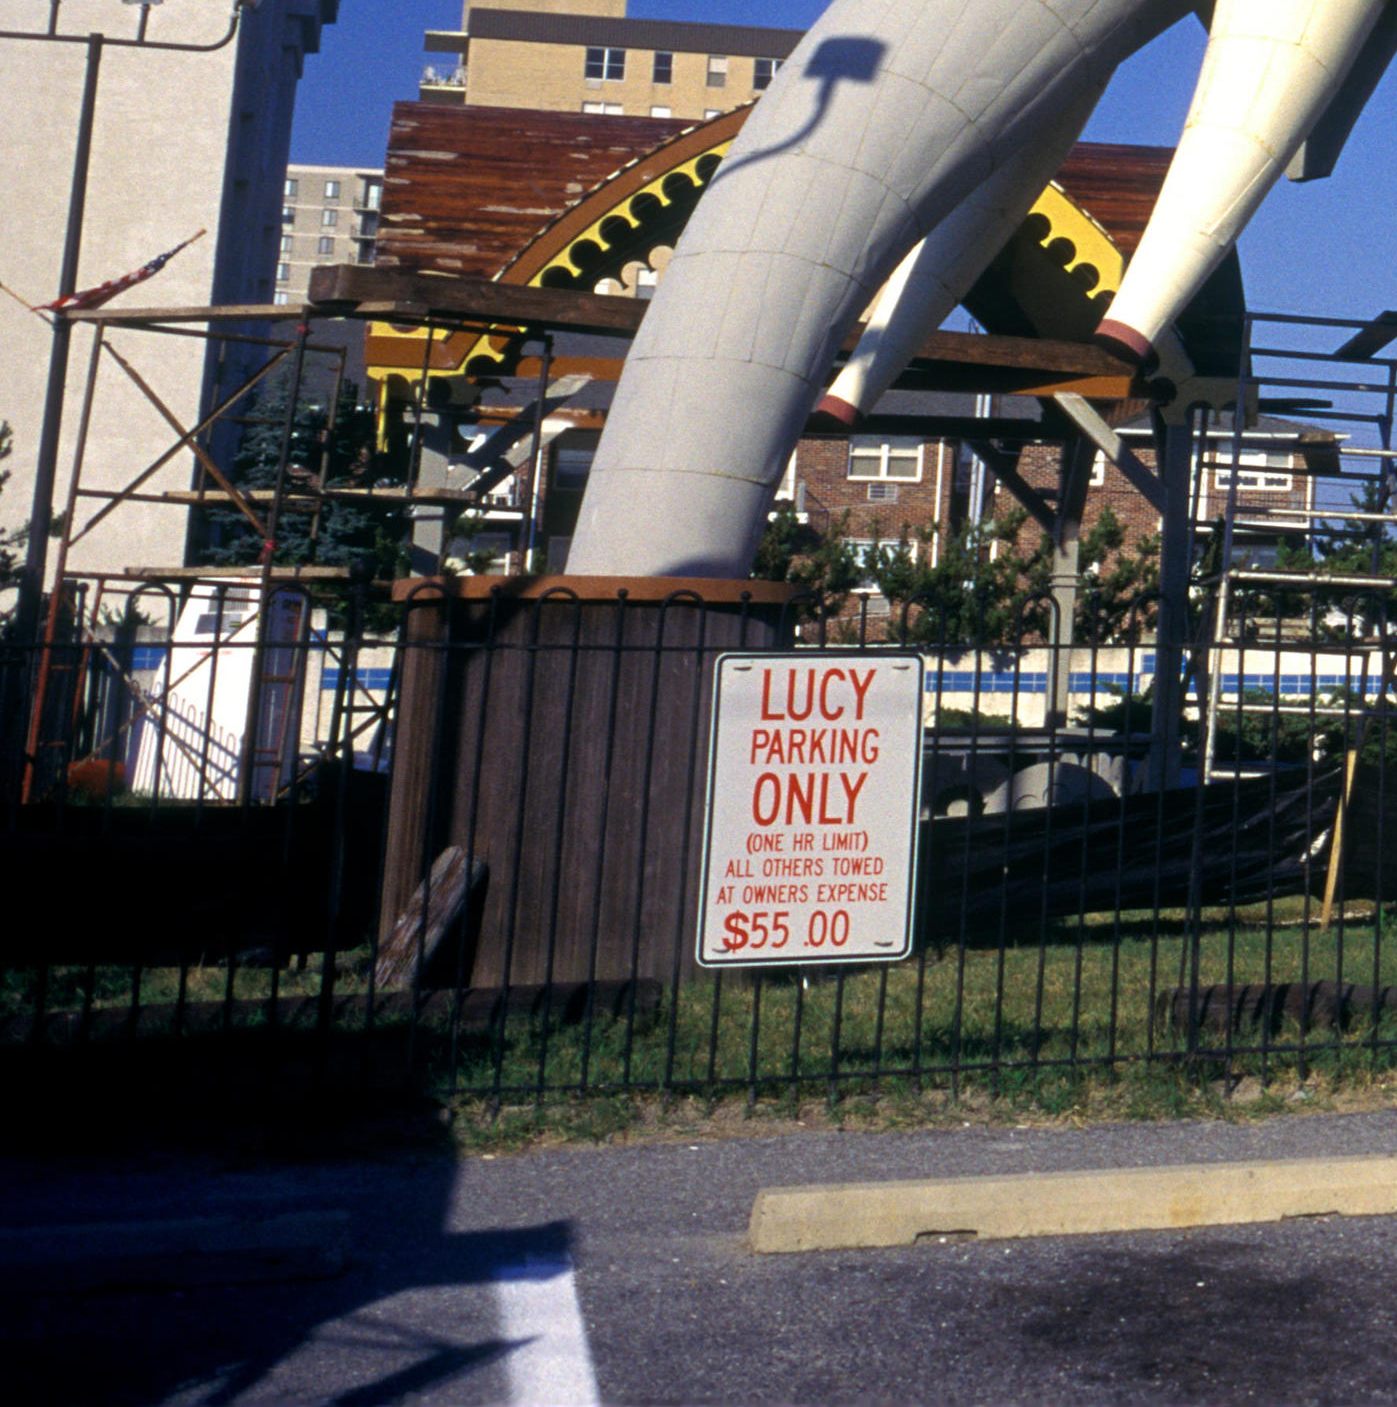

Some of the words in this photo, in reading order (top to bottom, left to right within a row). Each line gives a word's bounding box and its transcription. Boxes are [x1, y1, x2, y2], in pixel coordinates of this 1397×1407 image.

[761, 668, 876, 721] LUCY
[750, 728, 880, 764] PARKING
[753, 772, 868, 827] ONLY
[746, 833, 784, 854] (ONE
[793, 833, 814, 850] HR
[823, 831, 868, 852] LIMIT)
[725, 859, 754, 878] ALL
[763, 858, 824, 877] OTHERS
[833, 857, 884, 876] TOWED
[716, 884, 736, 904] AT
[742, 884, 808, 905] OWNERS
[817, 883, 888, 903] EXPENSE
